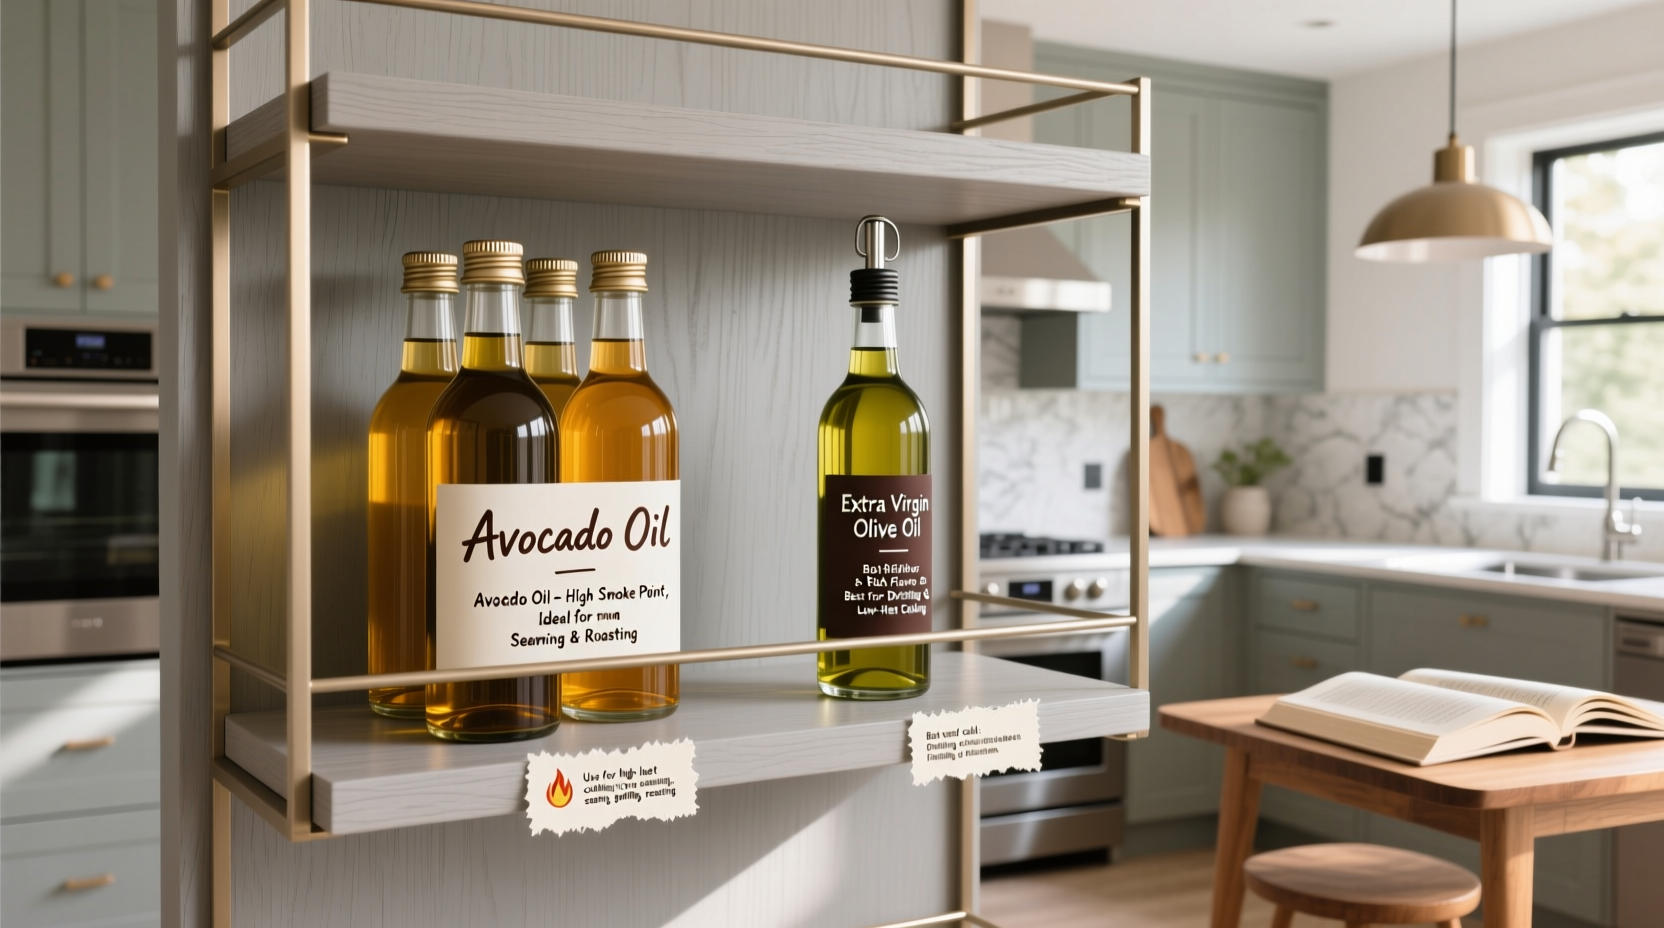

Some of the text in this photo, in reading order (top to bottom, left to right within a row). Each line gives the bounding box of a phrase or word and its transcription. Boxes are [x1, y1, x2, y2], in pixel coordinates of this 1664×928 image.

[841, 493, 929, 517] Extra Virgin
[462, 504, 671, 563] Avocado Oil
[853, 517, 921, 538] Olive Oil
[531, 589, 551, 605] Oil
[539, 610, 571, 626] Ideal
[574, 608, 593, 624] for
[570, 630, 580, 644] &
[585, 627, 638, 644] Roasting
